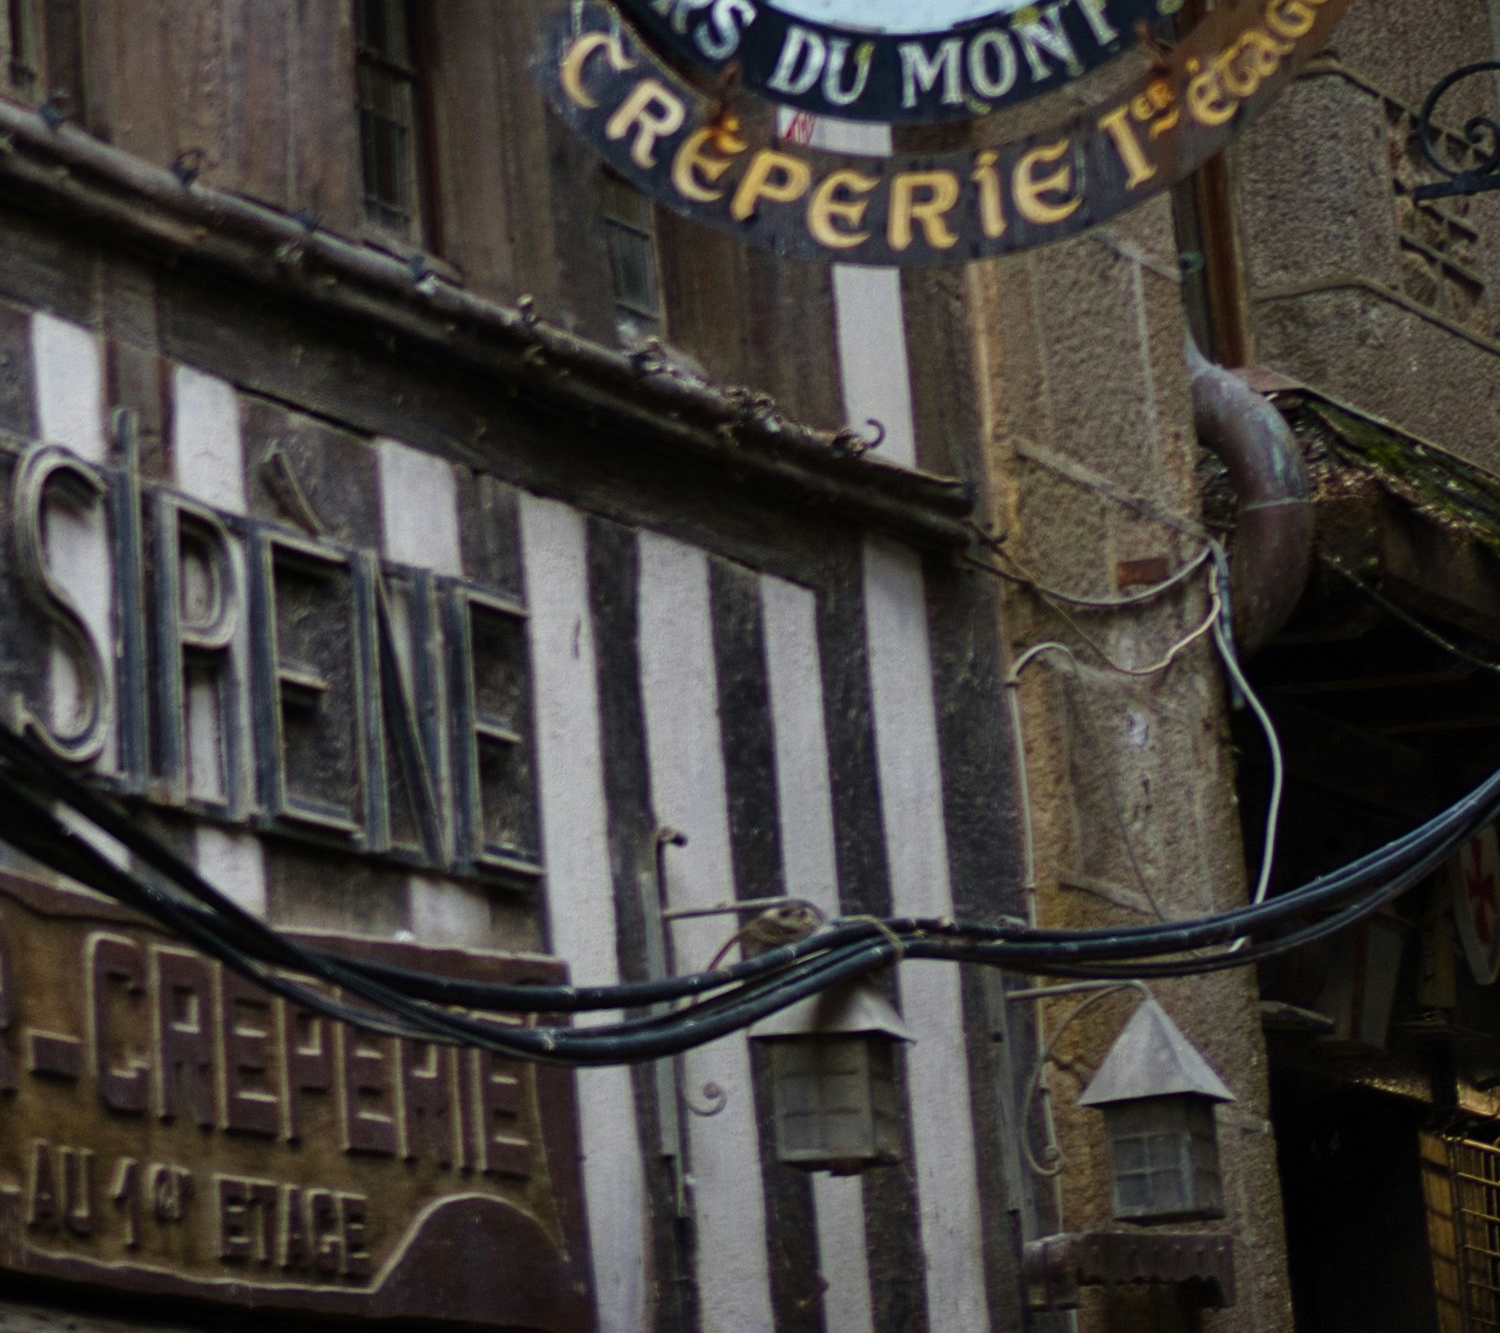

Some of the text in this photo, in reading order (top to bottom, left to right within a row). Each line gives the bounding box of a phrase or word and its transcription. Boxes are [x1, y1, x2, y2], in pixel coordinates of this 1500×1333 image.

[771, 23, 873, 105] DU
[27, 1137, 97, 1235] AU
[212, 1171, 371, 1279] ETAGE
